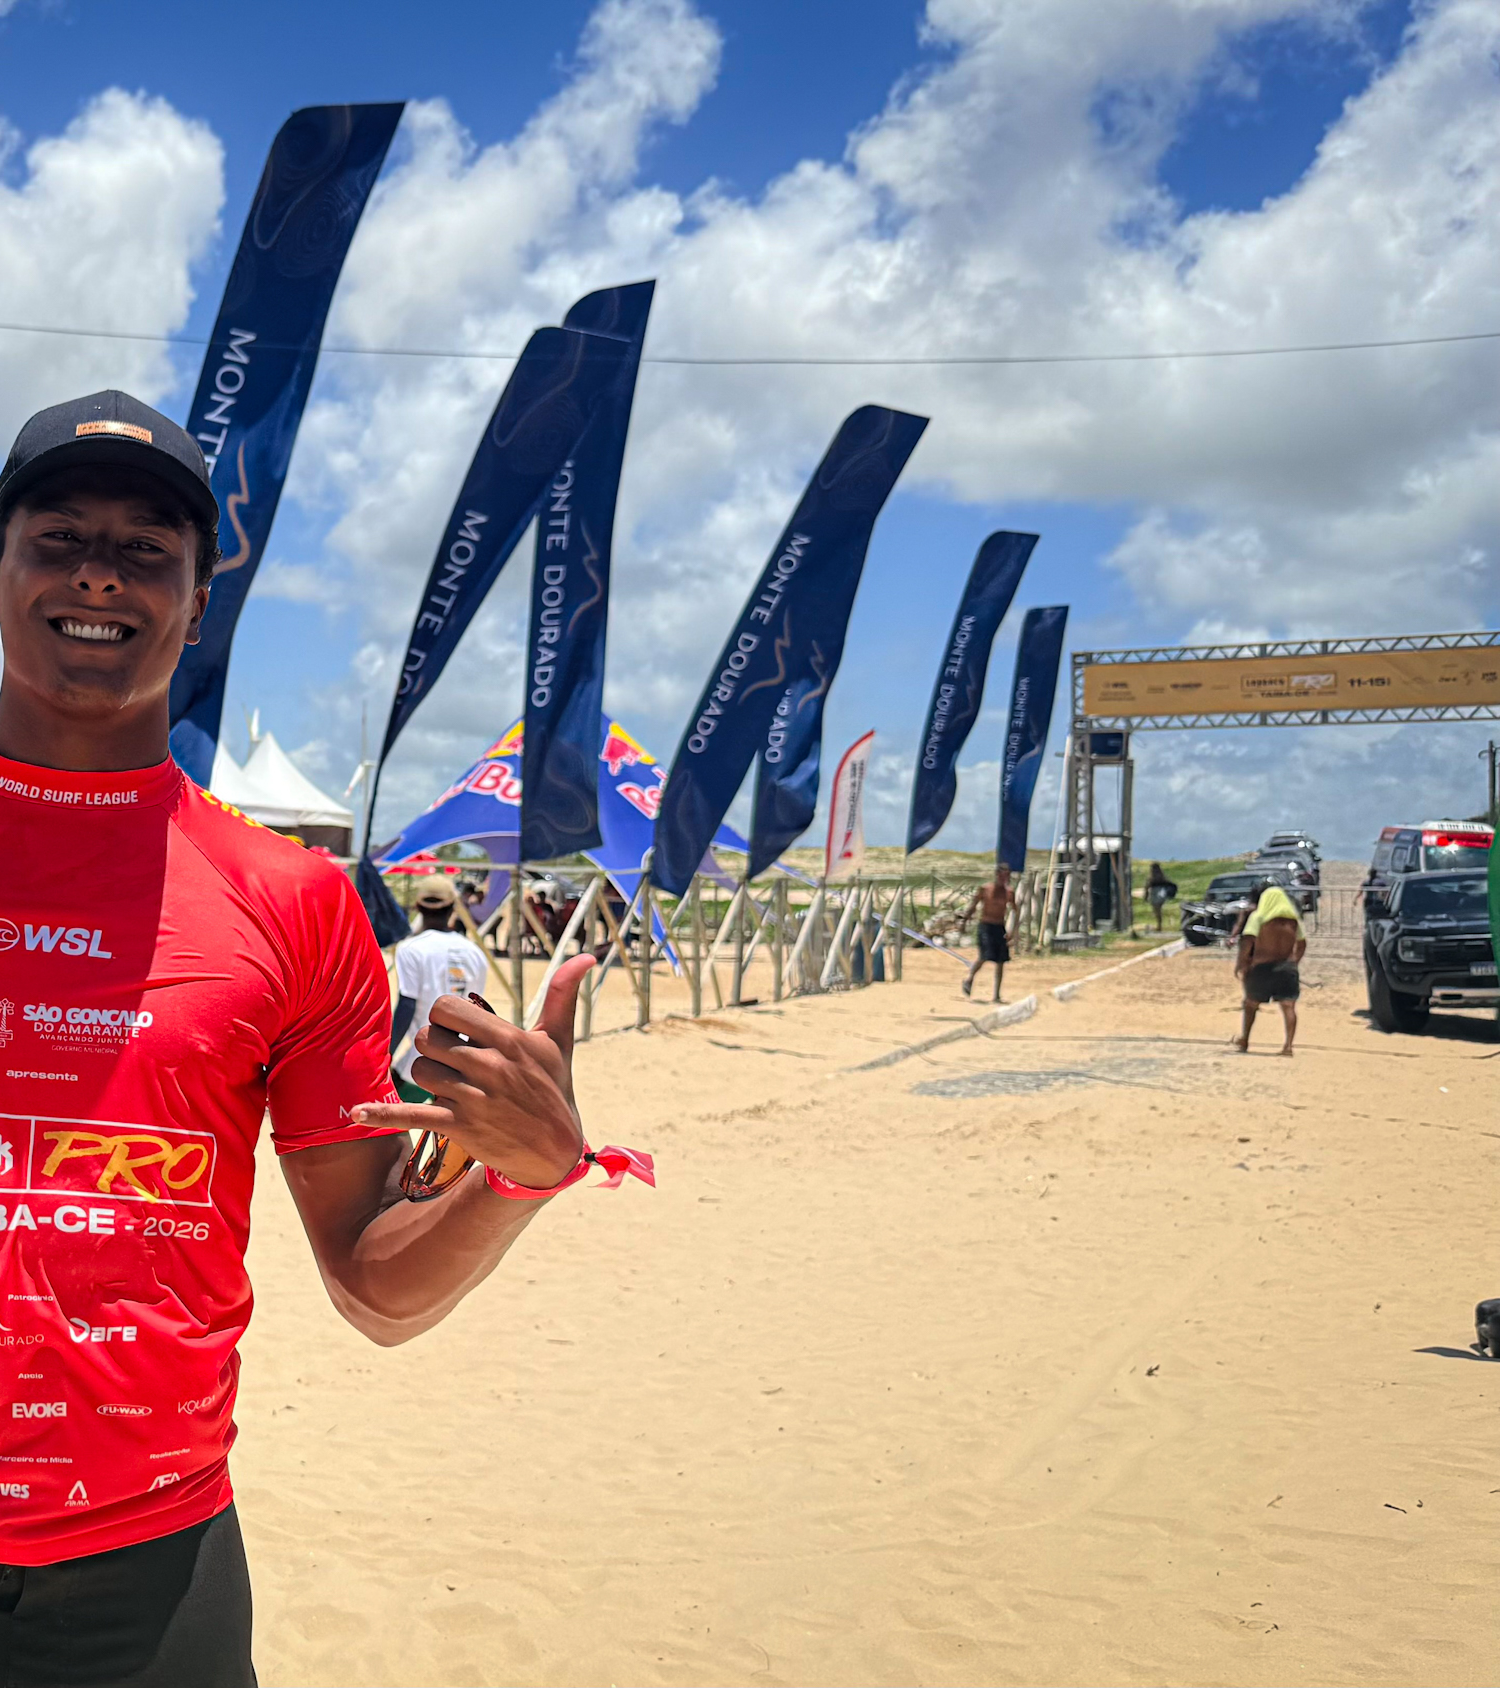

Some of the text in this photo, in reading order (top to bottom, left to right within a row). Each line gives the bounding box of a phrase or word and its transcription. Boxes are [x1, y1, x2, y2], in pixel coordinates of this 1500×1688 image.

[417, 509, 490, 635] MONTE
[531, 563, 567, 708] DOURADO
[687, 532, 812, 754] MONTE DOURADO
[945, 615, 976, 678] MONTE
[42, 789, 83, 804] SURF
[86, 790, 139, 805] LEAGUE
[24, 923, 112, 959] WSL
[23, 1003, 153, 1028] SÃO GONÇALO
[34, 1022, 140, 1037] DO AMARANTE
[39, 1033, 130, 1045] AVANÇANDO JUNTOS
[6, 1069, 79, 1082] apresenta
[40, 1131, 209, 1204] PRO
[143, 1217, 210, 1241] 2026
[13, 1402, 67, 1418] EVOKE
